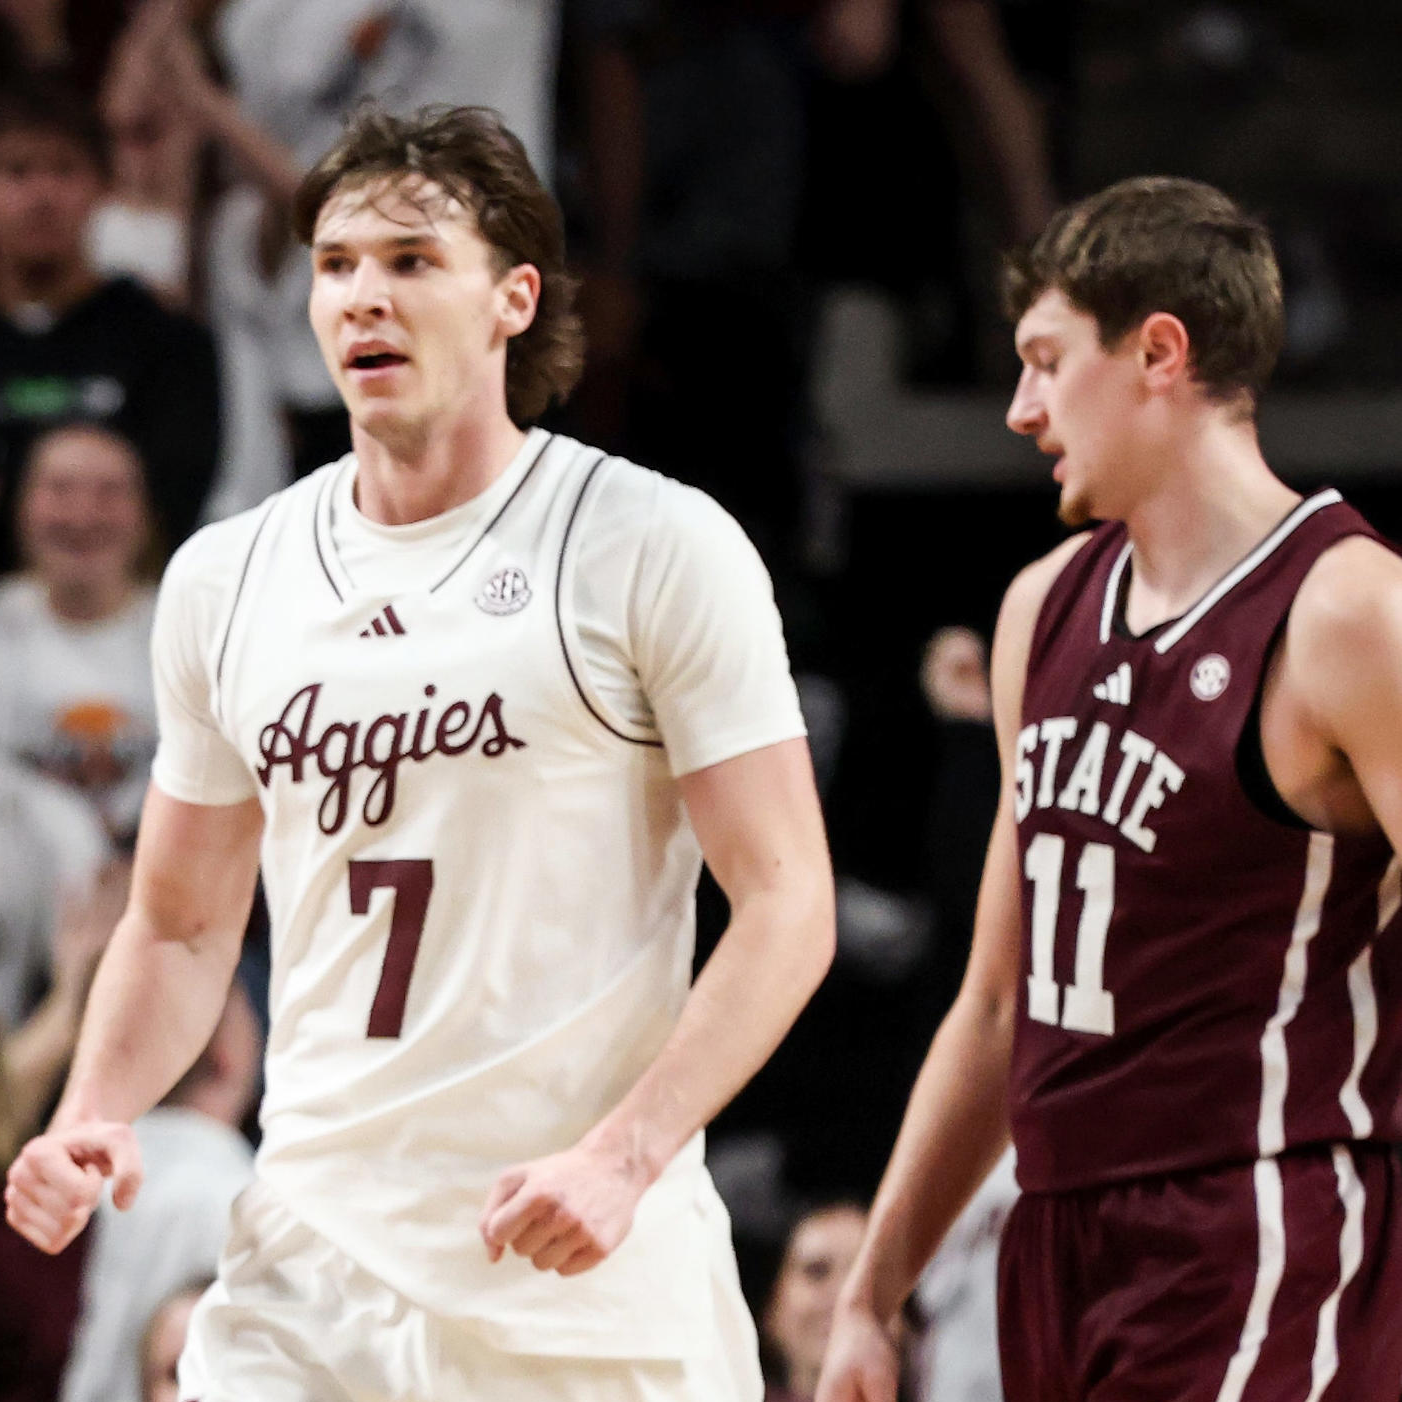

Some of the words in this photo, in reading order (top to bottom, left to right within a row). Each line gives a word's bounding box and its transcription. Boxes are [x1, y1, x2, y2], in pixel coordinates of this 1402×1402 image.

[257, 682, 528, 836] Aggies
[1014, 716, 1186, 853] STATE
[348, 858, 435, 1040] 7
[1024, 832, 1116, 1037] 11
